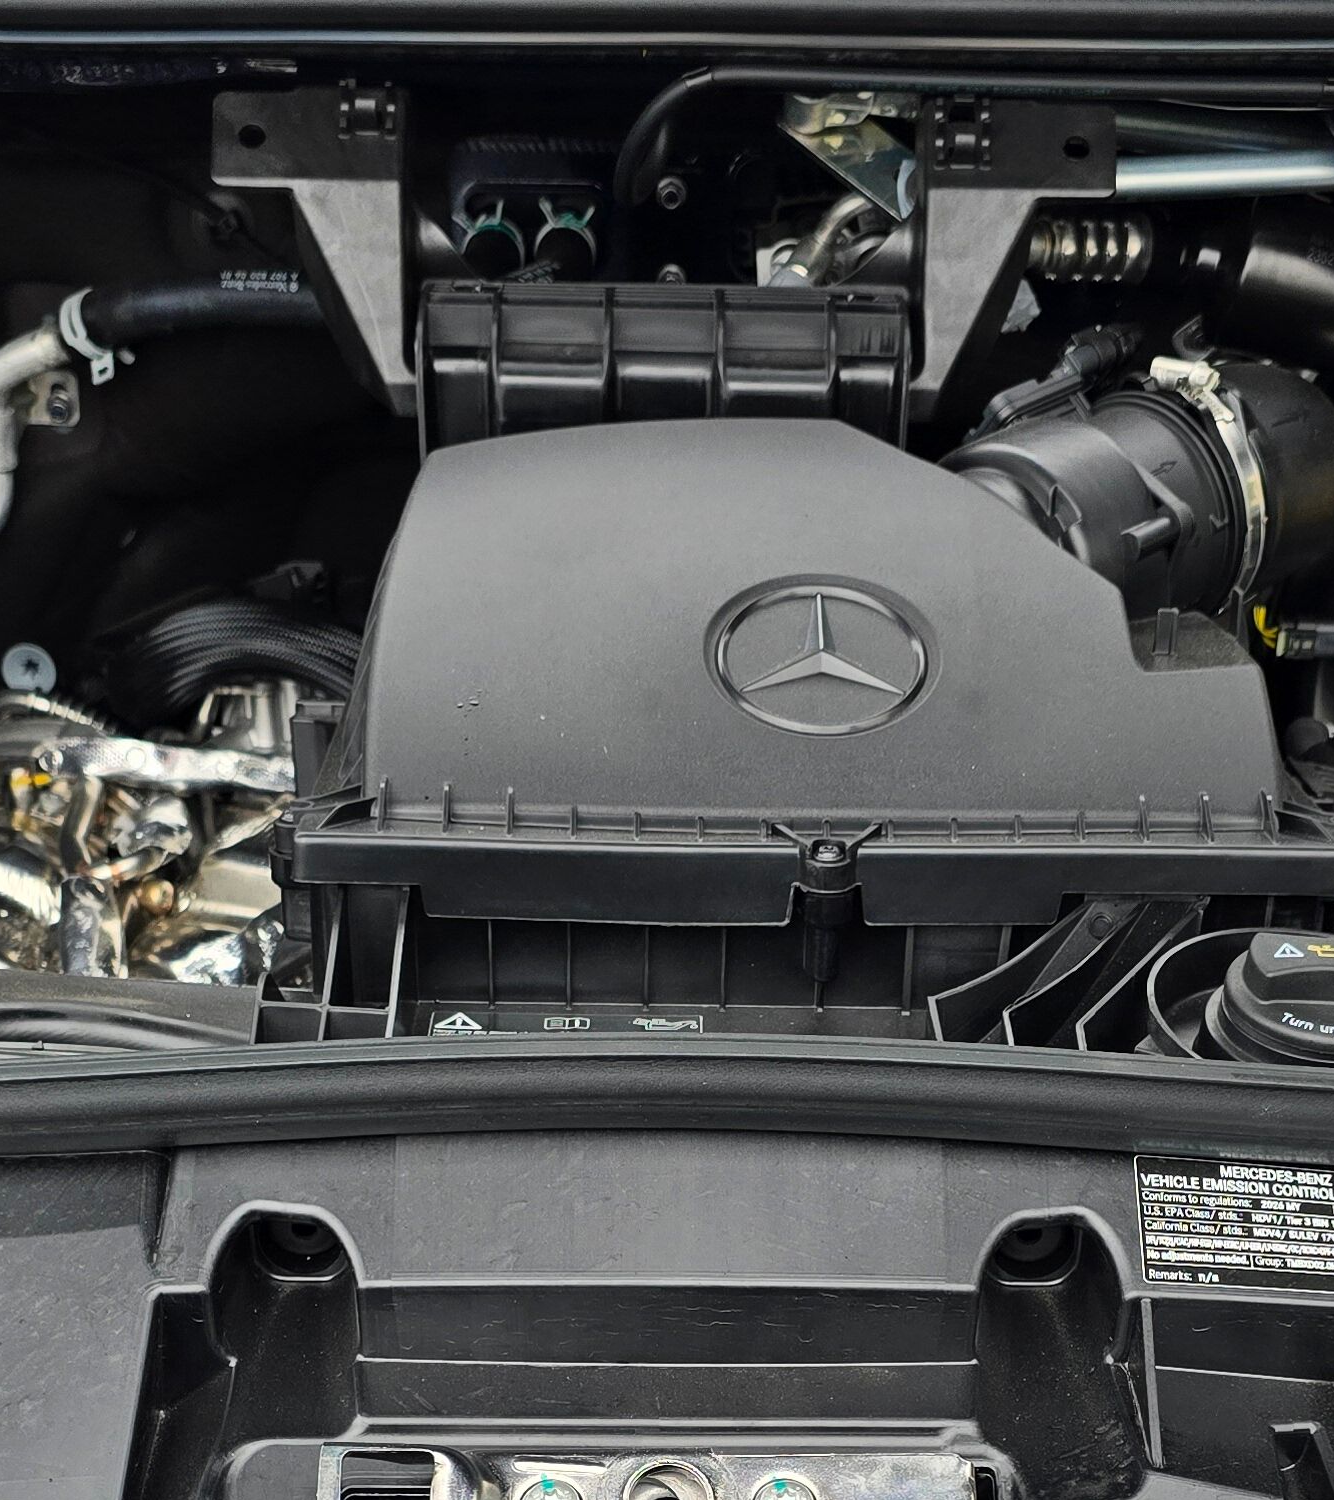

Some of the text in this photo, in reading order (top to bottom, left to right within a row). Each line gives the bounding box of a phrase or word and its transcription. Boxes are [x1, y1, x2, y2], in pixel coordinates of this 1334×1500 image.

[1280, 1012, 1314, 1031] Turn
[1219, 1165, 1333, 1187] MERCEDES-BENZ
[1140, 1173, 1200, 1190] VEHICLE
[1203, 1178, 1269, 1194] EMISSION
[1142, 1191, 1252, 1208] Conforms to regulations:
[1143, 1205, 1163, 1216] U.S.
[1165, 1207, 1184, 1218] EPA
[1285, 1202, 1301, 1212] MY
[1144, 1221, 1188, 1232] California
[1147, 1250, 1249, 1265] No adjustments needed.
[1255, 1257, 1284, 1268] Group:
[1149, 1269, 1219, 1283] Remarks: n/a
